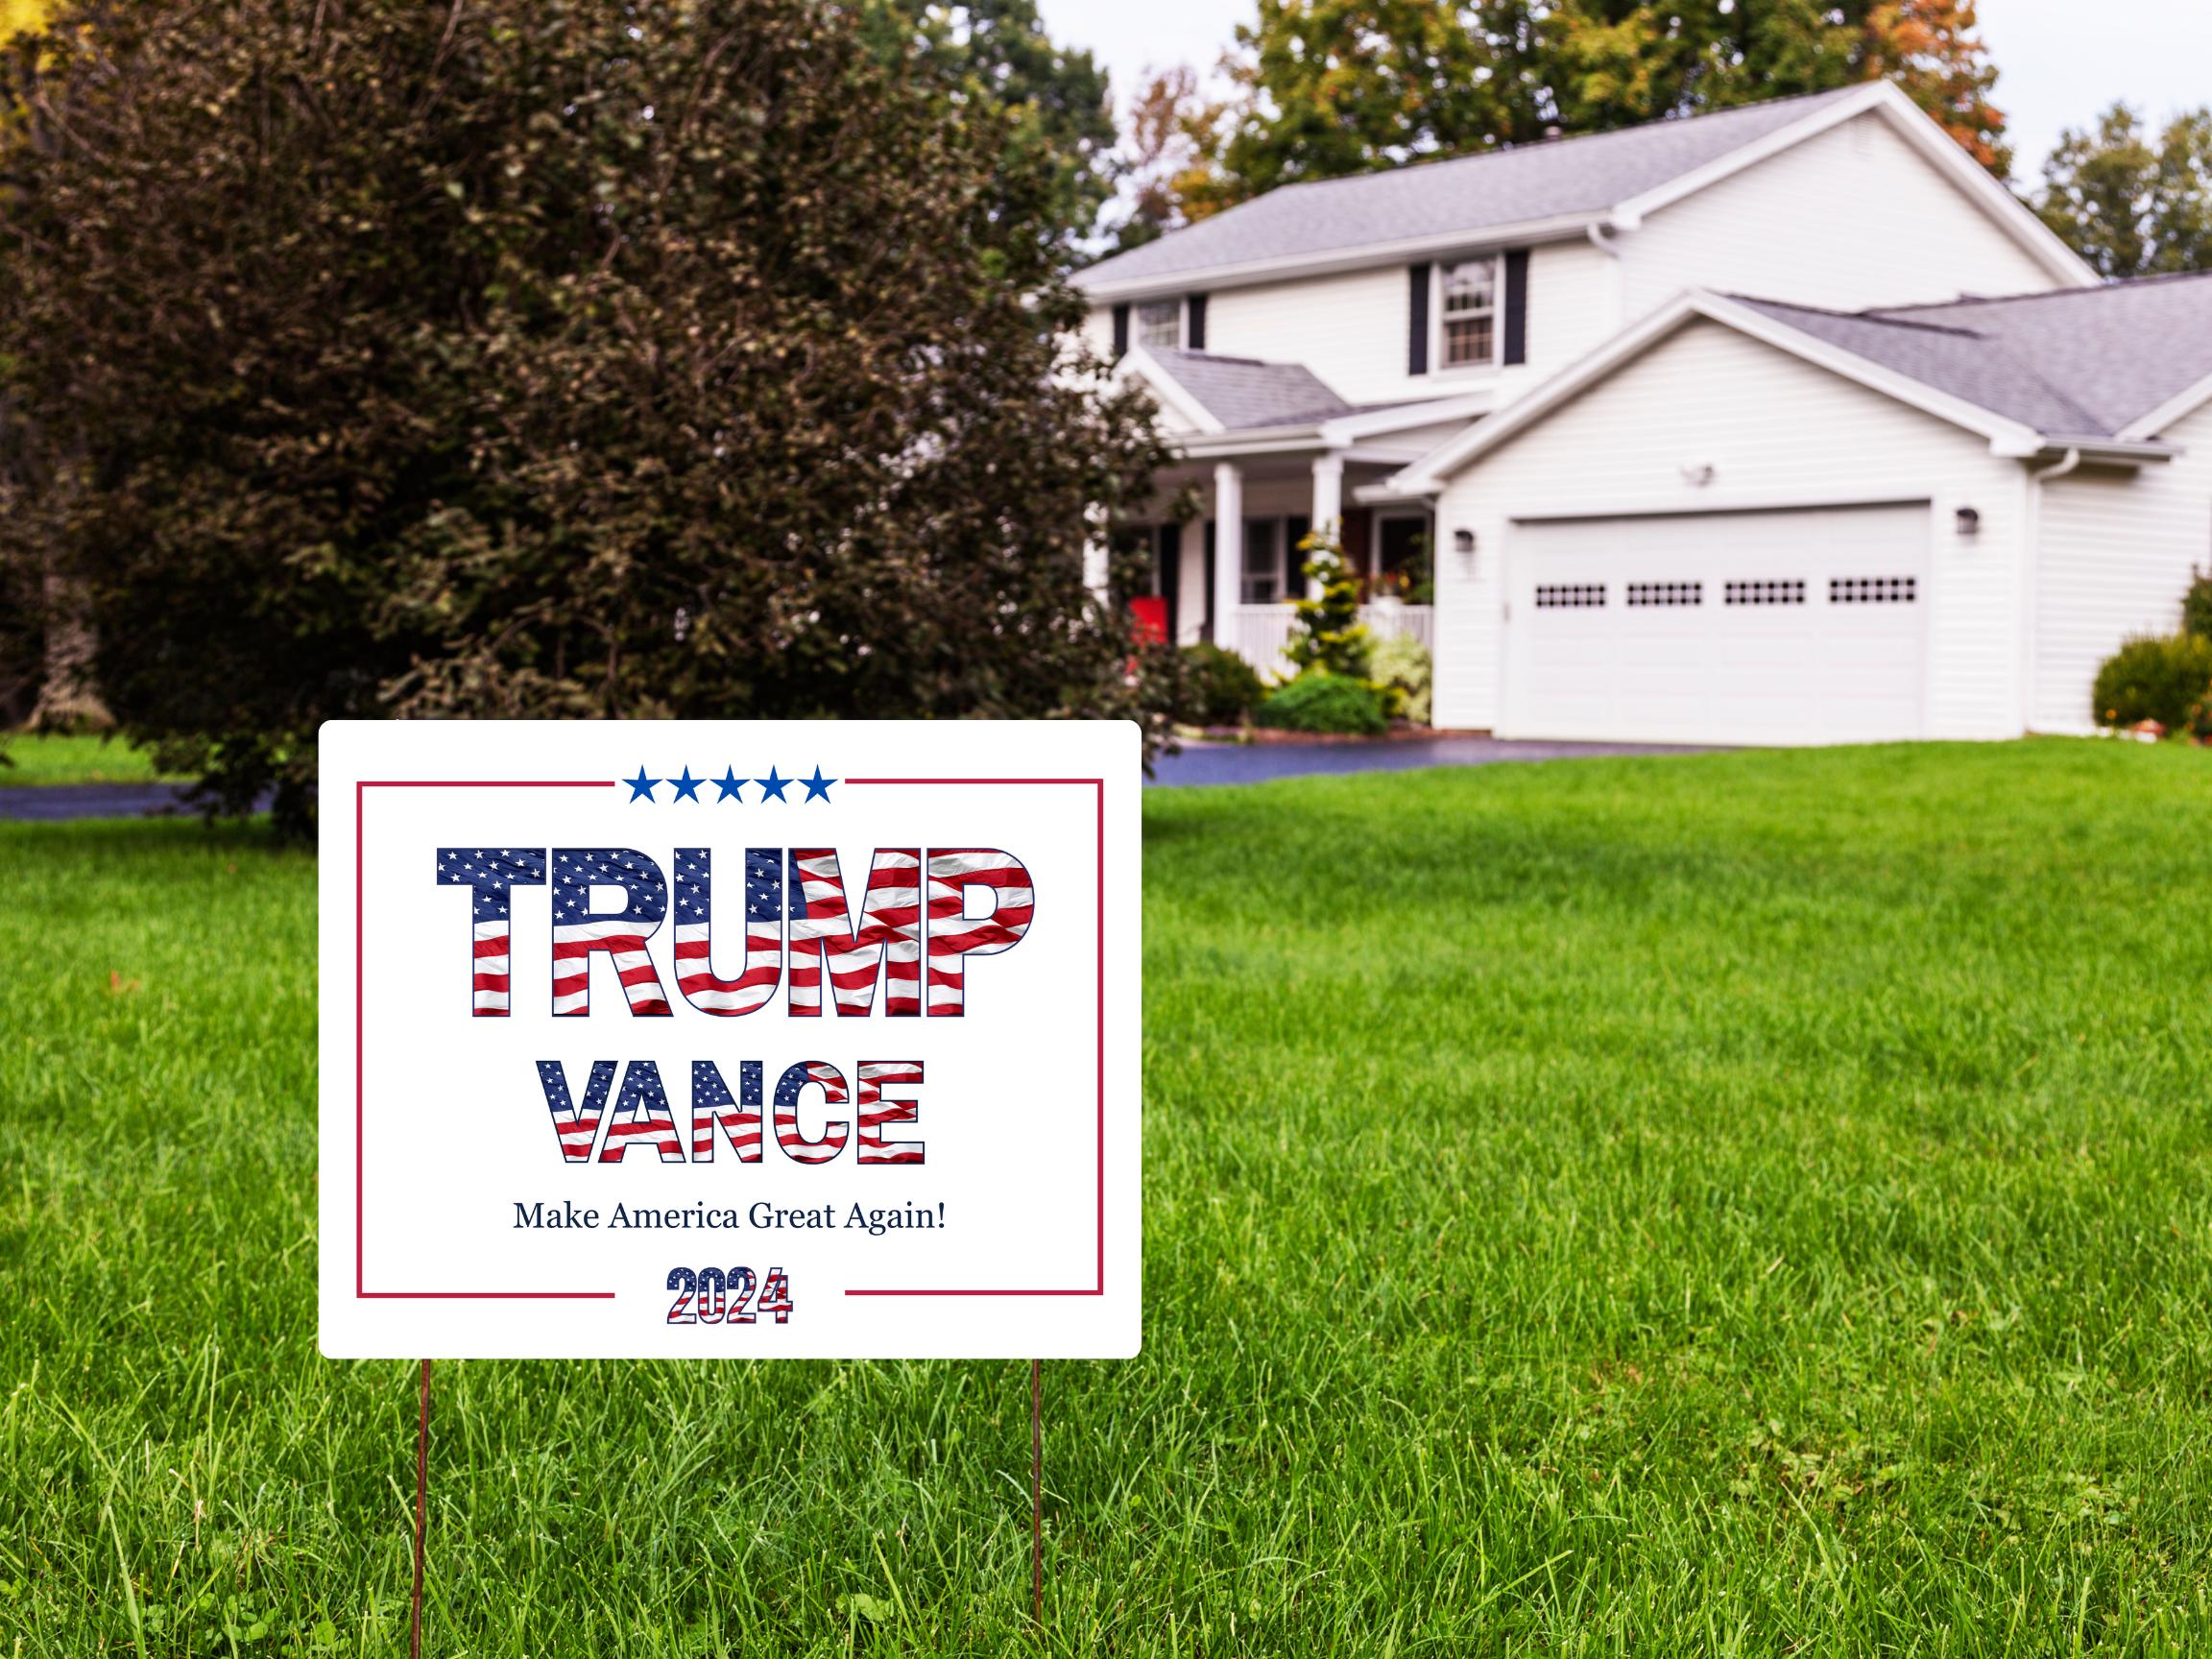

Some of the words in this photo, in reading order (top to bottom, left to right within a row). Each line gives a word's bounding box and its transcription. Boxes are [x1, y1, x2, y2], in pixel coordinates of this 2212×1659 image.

[437, 848, 1035, 1018] TRUMP
[536, 1060, 925, 1165] VANCE
[514, 1201, 600, 1229] Make
[608, 1201, 739, 1229] America
[749, 1201, 836, 1229] Great
[844, 1201, 946, 1236] Again!
[666, 1266, 793, 1325] 2024
